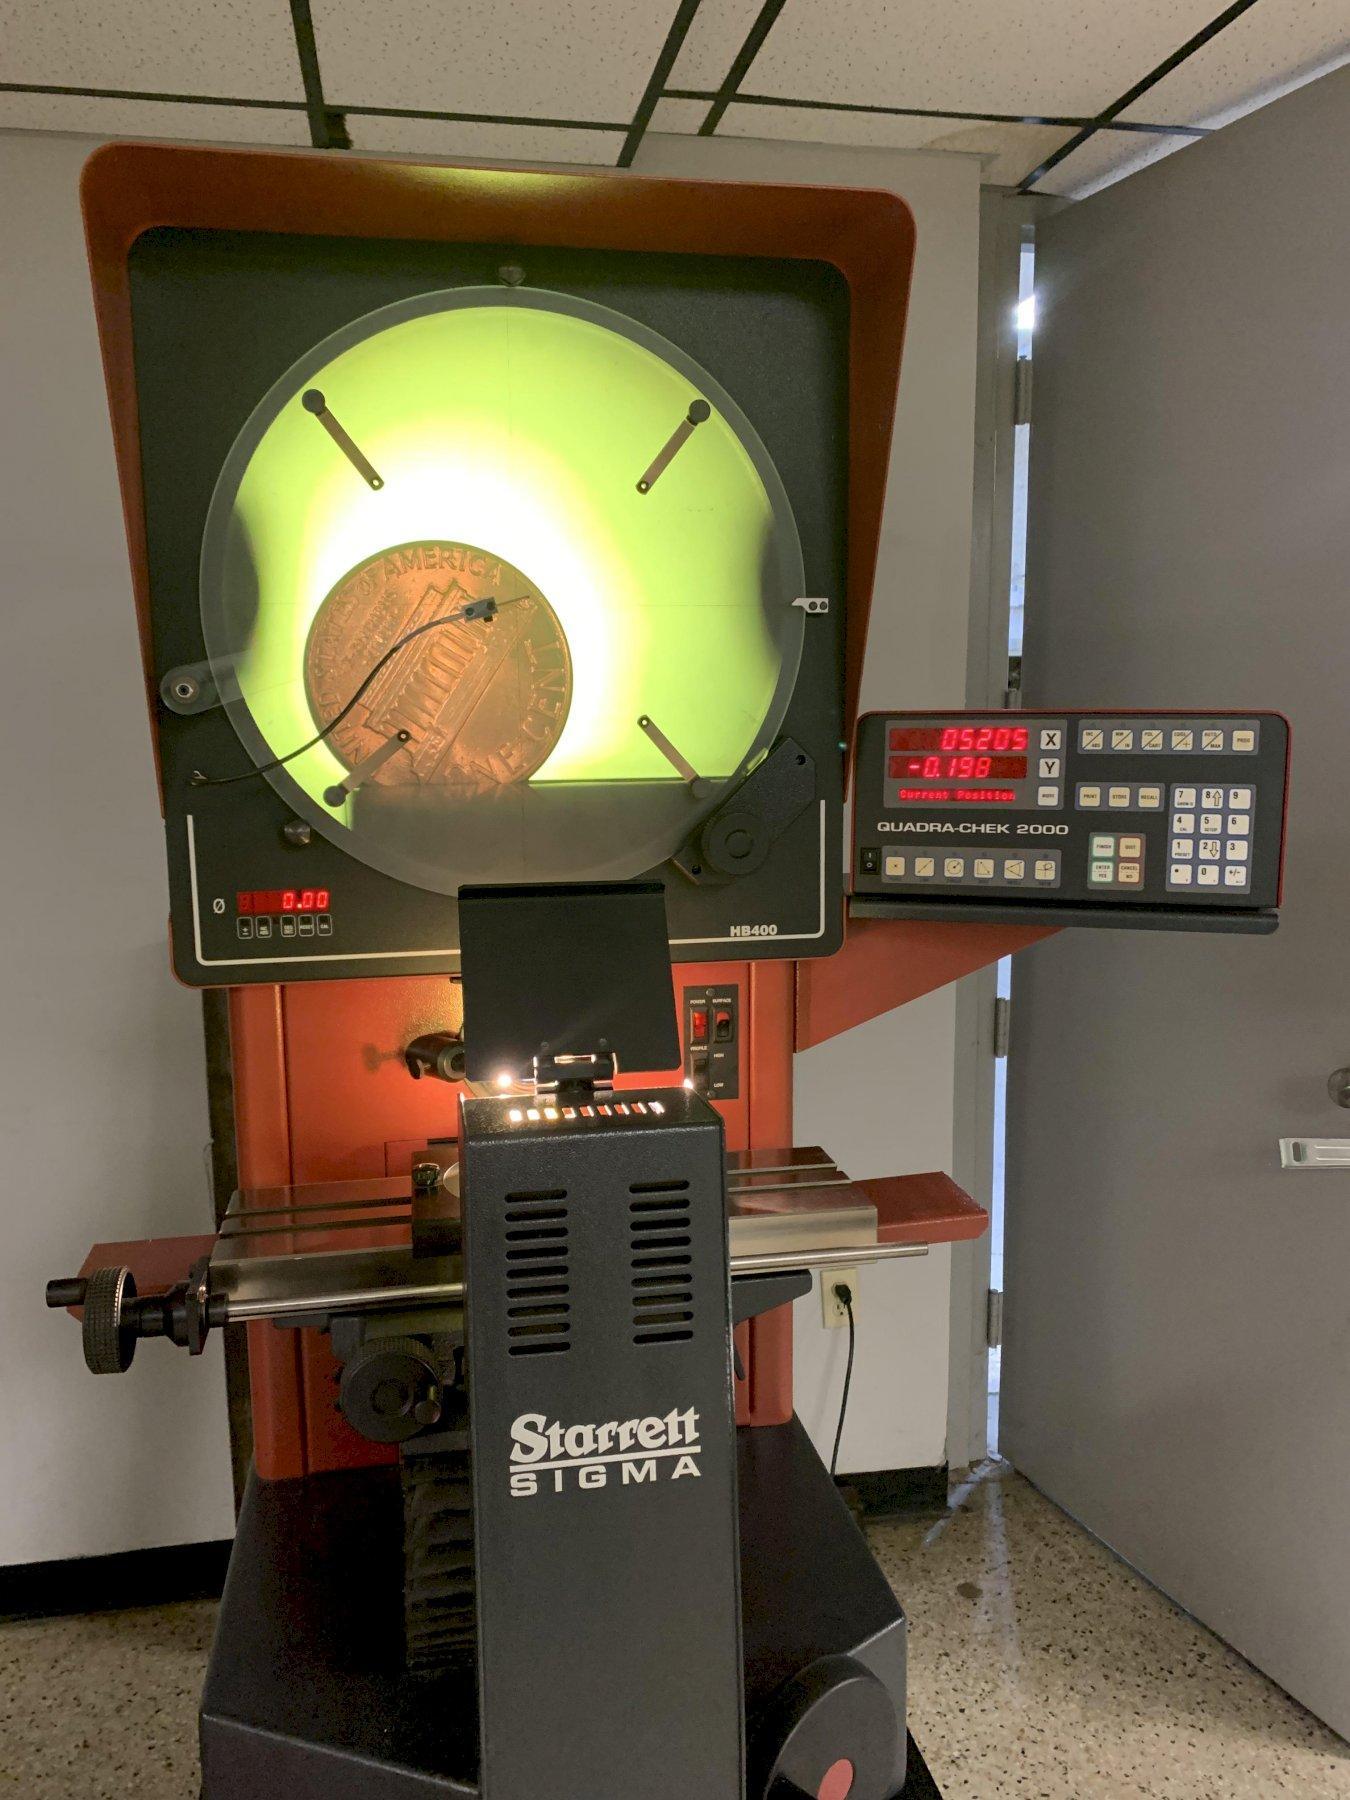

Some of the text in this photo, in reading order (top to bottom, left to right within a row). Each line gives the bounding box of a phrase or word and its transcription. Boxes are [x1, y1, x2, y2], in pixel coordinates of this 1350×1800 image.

[383, 546, 503, 586] AMERICA
[1045, 733, 1057, 746] X
[1045, 761, 1056, 775] Y
[900, 789, 1016, 801] Current Position
[1205, 791, 1211, 799] 8
[1232, 791, 1239, 799] 9
[1177, 816, 1182, 824] 4
[1204, 816, 1210, 824] 5
[1231, 817, 1237, 825] 6
[877, 822, 1069, 835] QUADRA-CHEK 2000
[1203, 842, 1208, 850] 2
[1201, 868, 1207, 876] 0
[283, 892, 328, 909] 0.00
[730, 924, 777, 937] HB400
[509, 1405, 701, 1463] Starrett
[509, 1455, 702, 1497] SIGMA
